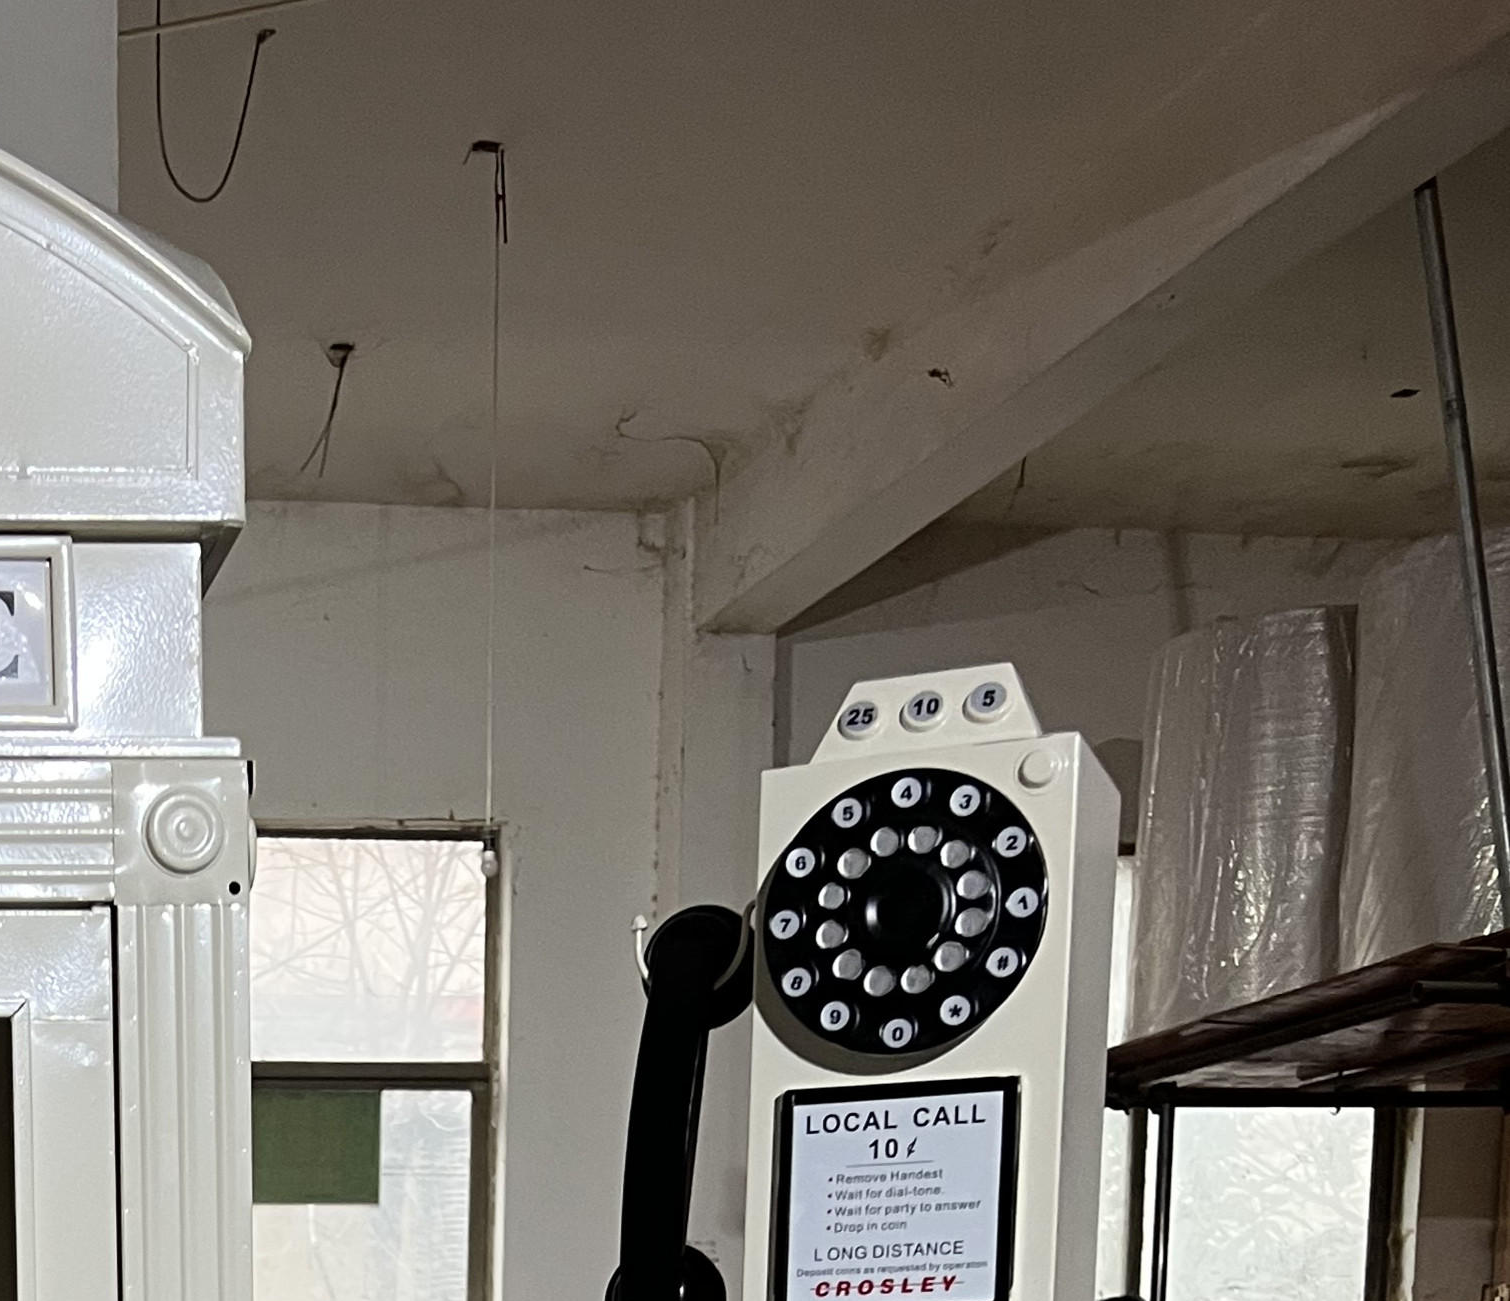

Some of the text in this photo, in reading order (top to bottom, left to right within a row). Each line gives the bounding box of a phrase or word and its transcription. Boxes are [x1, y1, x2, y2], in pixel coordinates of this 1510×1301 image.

[981, 689, 996, 707] 5
[913, 697, 940, 716] 10
[846, 706, 875, 726] 25
[900, 784, 913, 801] 4
[959, 793, 973, 809] 3
[842, 805, 854, 821] 5
[1005, 835, 1019, 851] 2
[794, 855, 807, 871] 6
[1017, 895, 1030, 911] 1
[780, 917, 792, 933] 7
[791, 974, 803, 990] 8
[829, 1007, 841, 1024] 9
[891, 1025, 903, 1041] 0
[805, 1103, 987, 1135] LOCAL CALL
[868, 1137, 899, 1160] 10
[836, 1173, 887, 1185] Remove
[835, 1189, 864, 1201] Wait
[866, 1187, 883, 1199] for
[834, 1200, 981, 1217] Wait for party to answer
[834, 1220, 907, 1234] Drop in coin
[813, 1239, 965, 1262] LONG DISTANCE
[928, 1261, 941, 1273] by
[814, 1274, 958, 1298] CROSLEY
